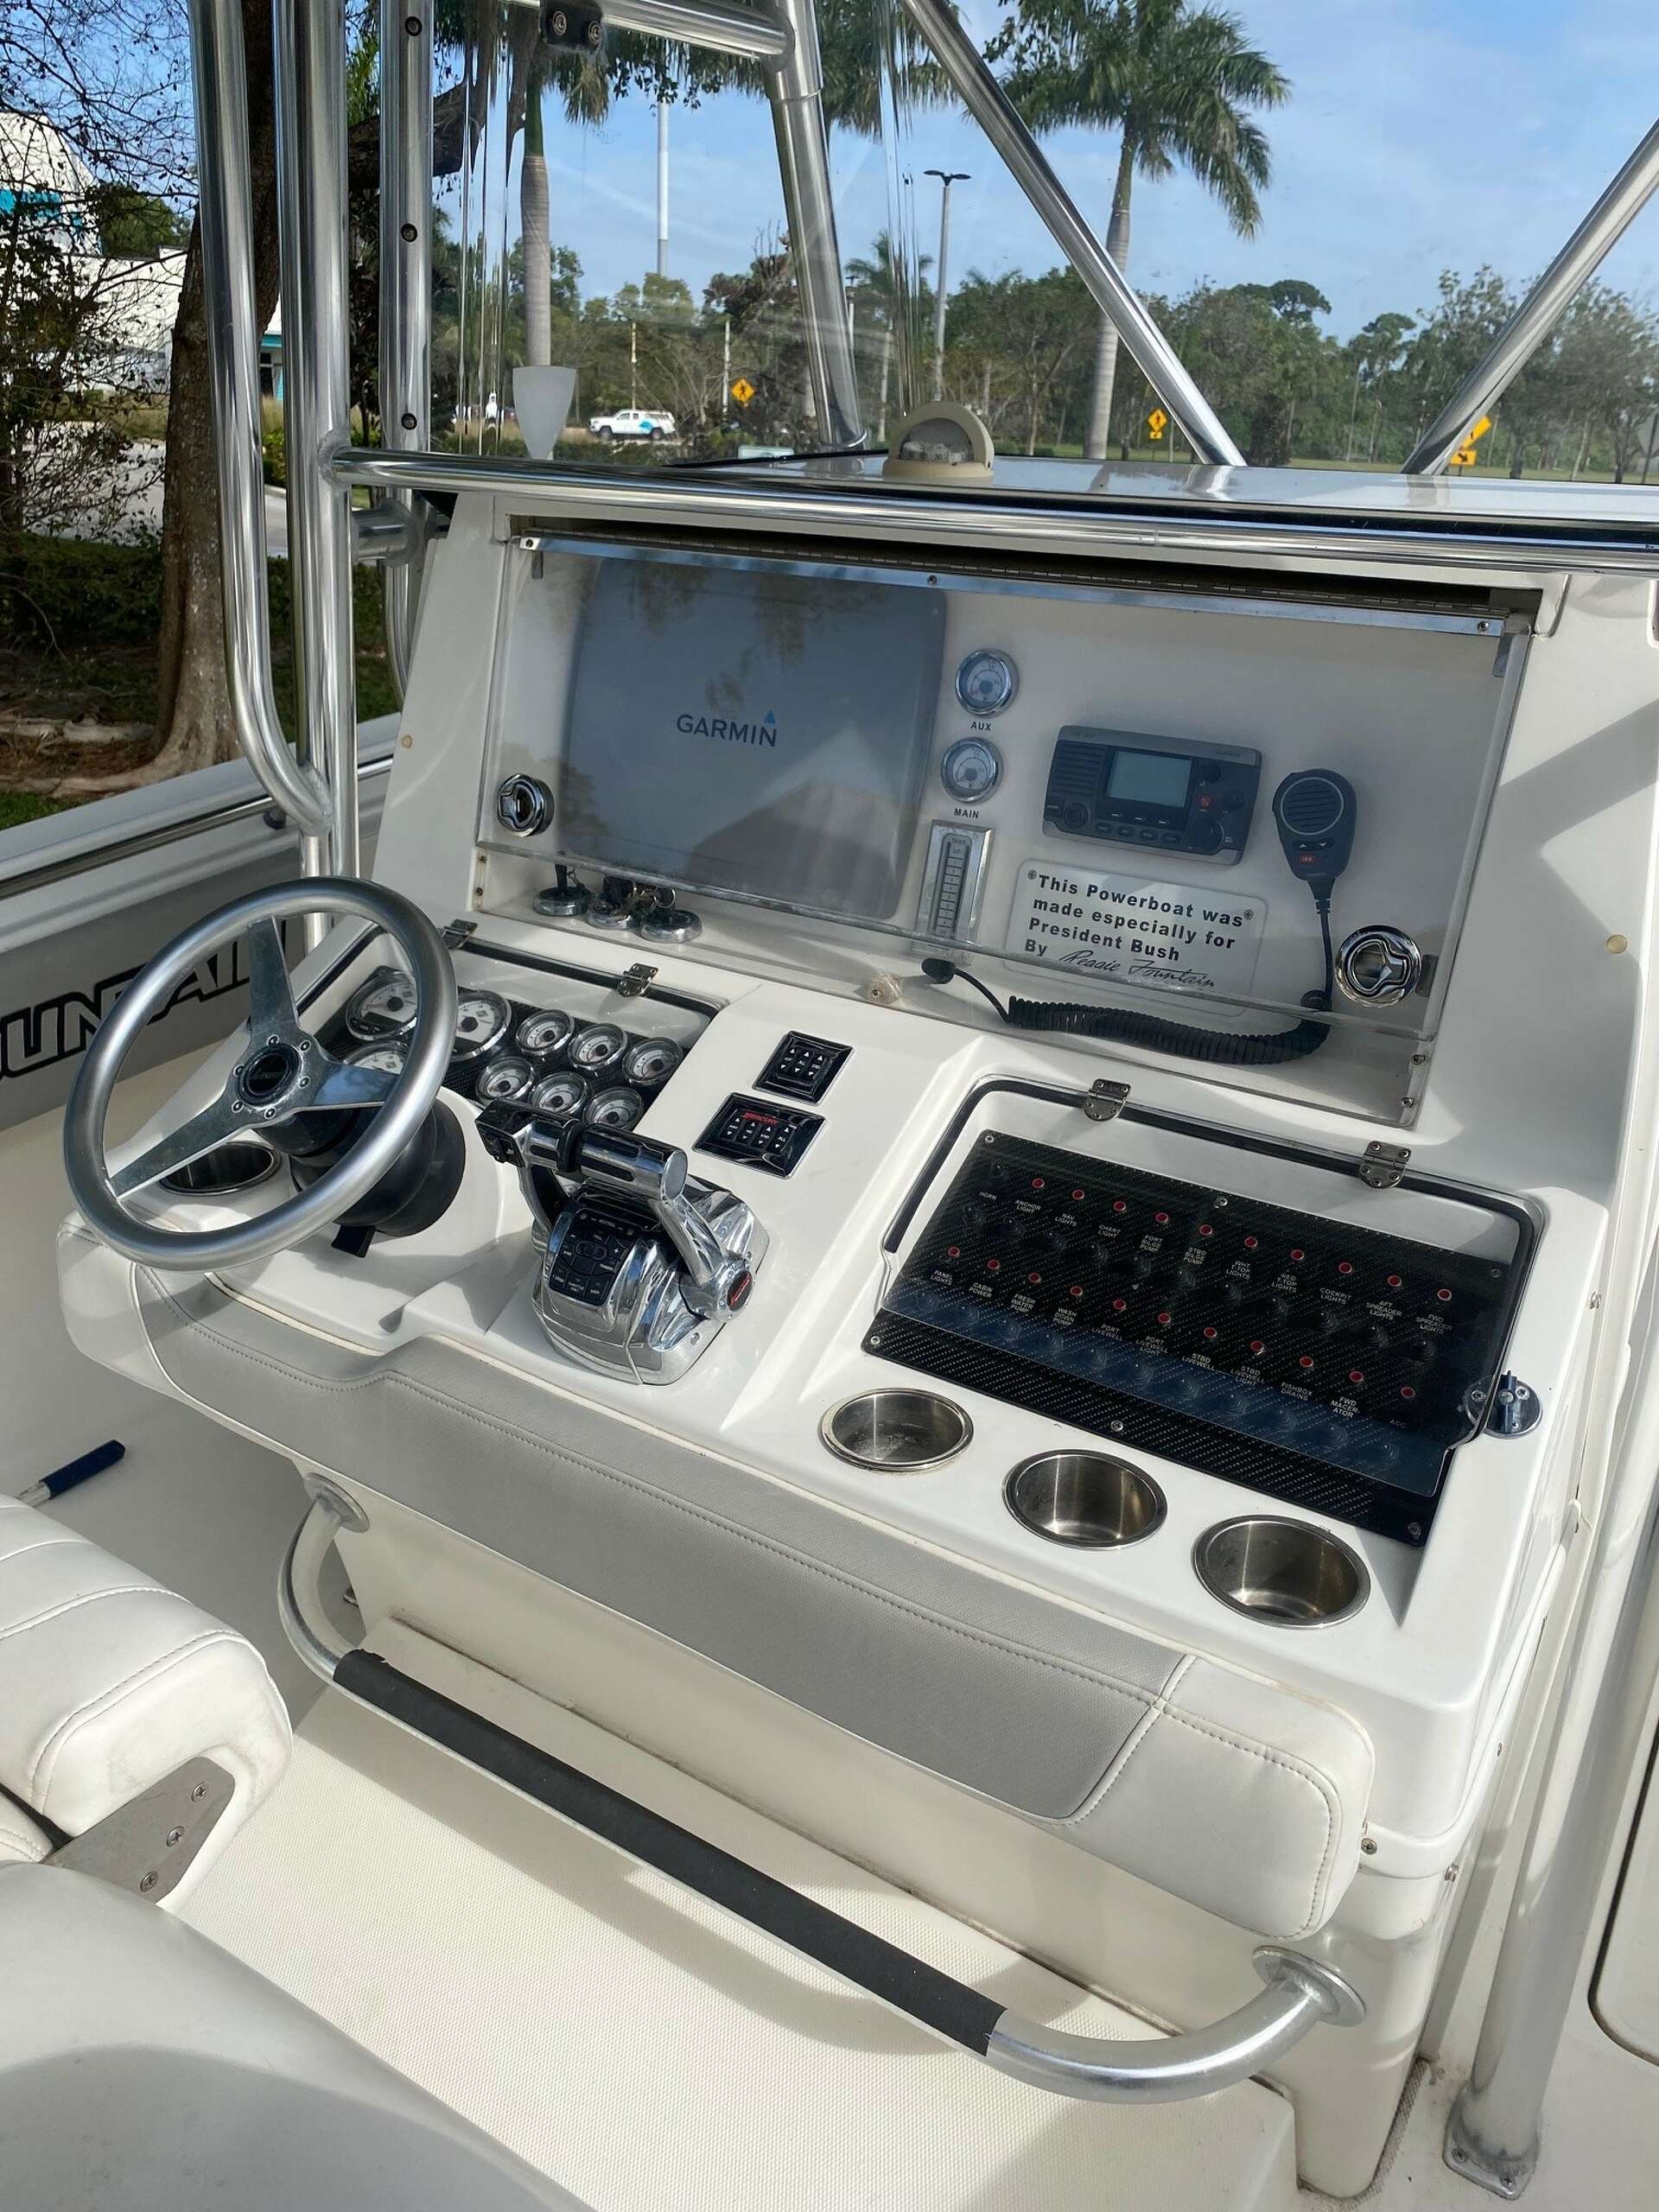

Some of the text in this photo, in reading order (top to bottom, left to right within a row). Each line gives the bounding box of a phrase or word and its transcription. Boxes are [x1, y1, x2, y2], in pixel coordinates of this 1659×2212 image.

[677, 714, 777, 747] GARMIN
[970, 721, 992, 732] AUX
[954, 808, 980, 819] MAIN
[1038, 874, 1243, 927] This Powerboat was
[1033, 898, 1236, 950] made especially for
[1028, 917, 1180, 962] President Bush
[1025, 938, 1048, 957] By
[1128, 958, 1216, 988] Fountain
[979, 1192, 997, 1200] HORN
[1015, 1199, 1041, 1211] ANCHOR
[1016, 1205, 1035, 1214] LIGHT
[1055, 1217, 1077, 1227] LIGHTS
[1097, 1230, 1116, 1238] LIGHT
[1145, 1235, 1163, 1244] PORT
[1140, 1244, 1158, 1253] PUMP
[1226, 1268, 1250, 1280] LIGHTS
[1281, 1273, 1296, 1281] RED
[931, 1274, 952, 1286] LIGHTS
[1277, 1277, 1297, 1287] T-TOP
[969, 1287, 992, 1298] POWER
[973, 1282, 993, 1293] CABIN
[1271, 1281, 1296, 1294] LIGHTS
[1319, 1287, 1351, 1300] COCKPIT
[1320, 1294, 1346, 1306] LIGHTS
[1058, 1307, 1077, 1317] WASH
[1366, 1302, 1402, 1318] SPREADER
[1370, 1309, 1394, 1320] LIGHTS
[1053, 1318, 1072, 1326] PUMP
[1091, 1326, 1122, 1341] LIVEWELL
[1101, 1324, 1121, 1333] PORT
[1145, 1336, 1165, 1345] PORT
[1135, 1339, 1168, 1354] LIVEWELL
[1140, 1346, 1160, 1356] LIGHT
[1181, 1356, 1215, 1371] LIVEWELL
[1192, 1353, 1211, 1363] STBD
[1230, 1368, 1265, 1383] LIVEWELL
[1241, 1365, 1261, 1376] STBD
[1235, 1376, 1257, 1387] LIGHT
[1281, 1382, 1313, 1397] FISHBOX
[1281, 1388, 1309, 1402] DRAINS
[1331, 1400, 1360, 1414] MACER-
[1339, 1396, 1357, 1407] FWD
[1332, 1408, 1354, 1418] ATOR
